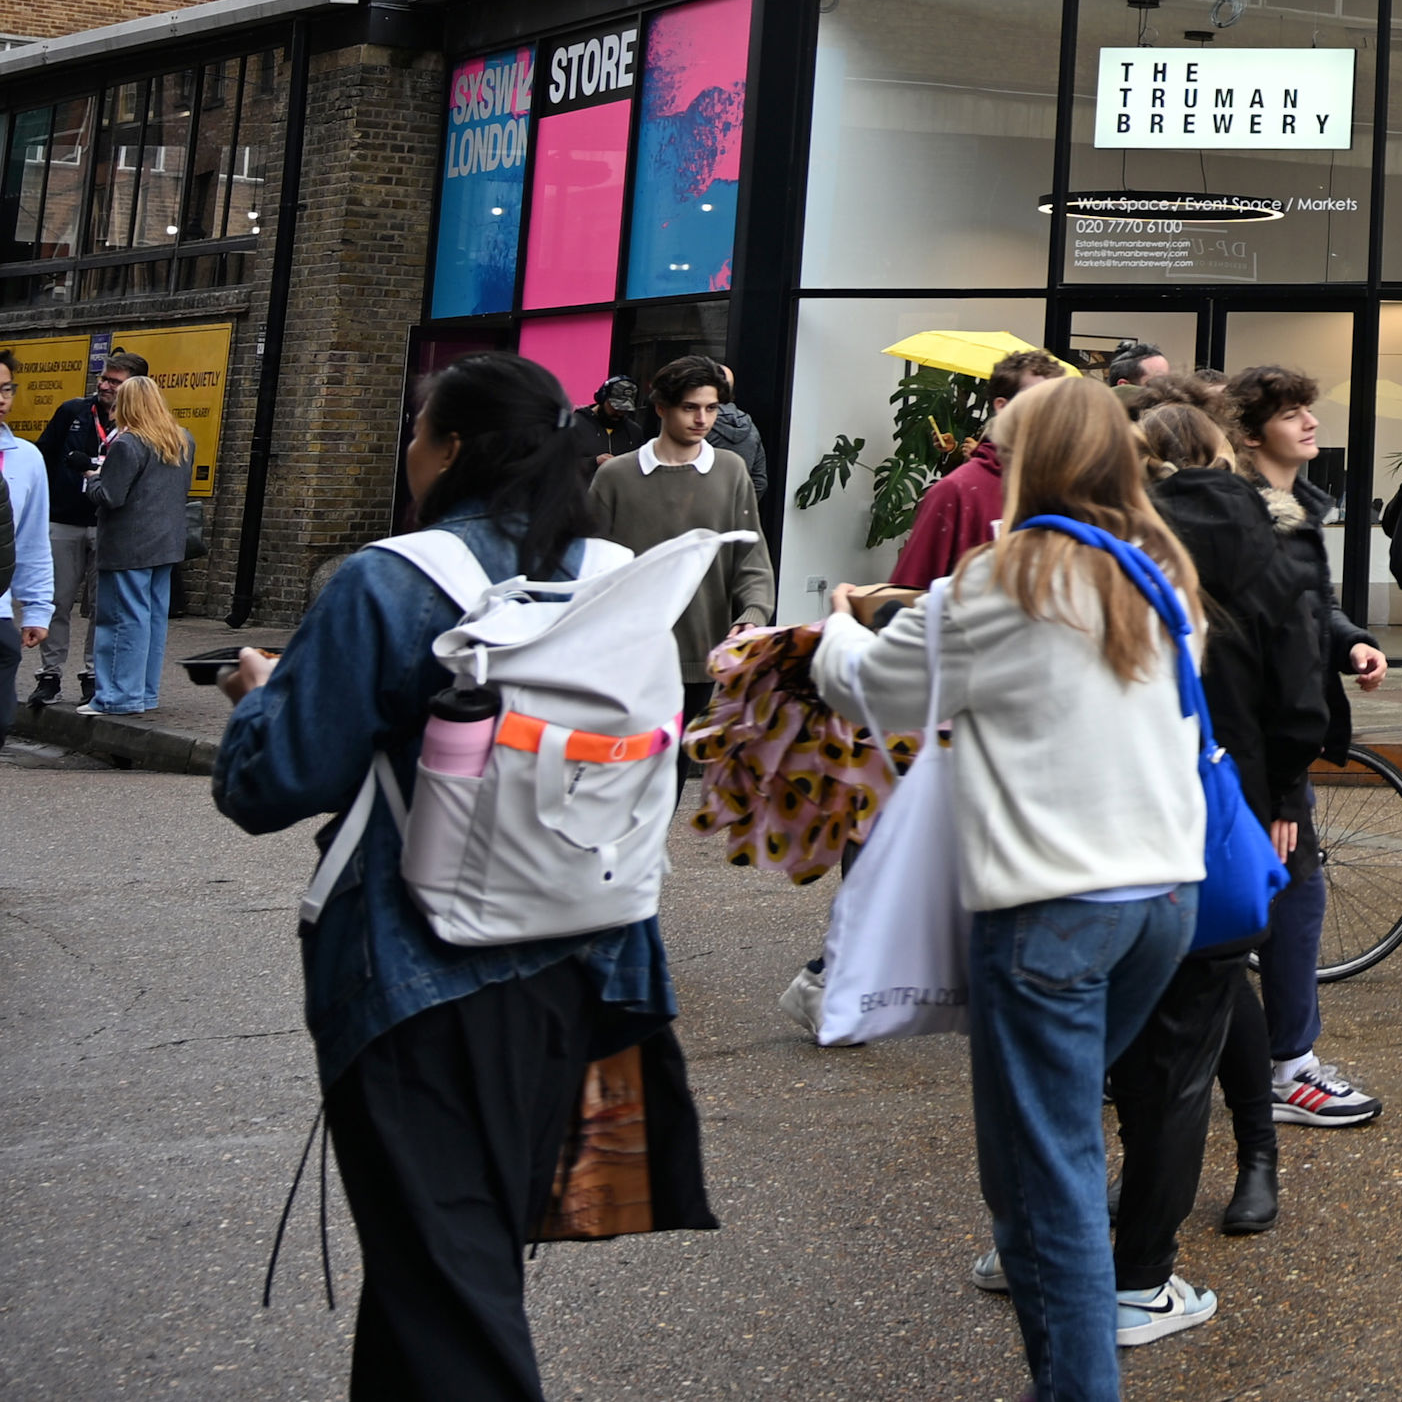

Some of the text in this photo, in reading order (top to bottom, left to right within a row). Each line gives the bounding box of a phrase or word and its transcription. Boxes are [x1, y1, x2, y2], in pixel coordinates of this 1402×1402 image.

[548, 28, 638, 104] STORE
[1120, 62, 1199, 83] THE
[452, 61, 519, 126] SXSW
[1119, 88, 1298, 109] TRUMAN
[1116, 113, 1330, 134] BREWERY
[447, 117, 528, 179] LONDON
[1077, 197, 1116, 211] Work
[1118, 197, 1170, 215] Space
[1185, 197, 1229, 211] Event
[1230, 197, 1283, 215] Space
[1297, 197, 1358, 212] Markets
[1075, 220, 1183, 234] 020 7770 6100
[167, 372, 189, 388] LEAVE
[190, 371, 221, 390] QUIETLY
